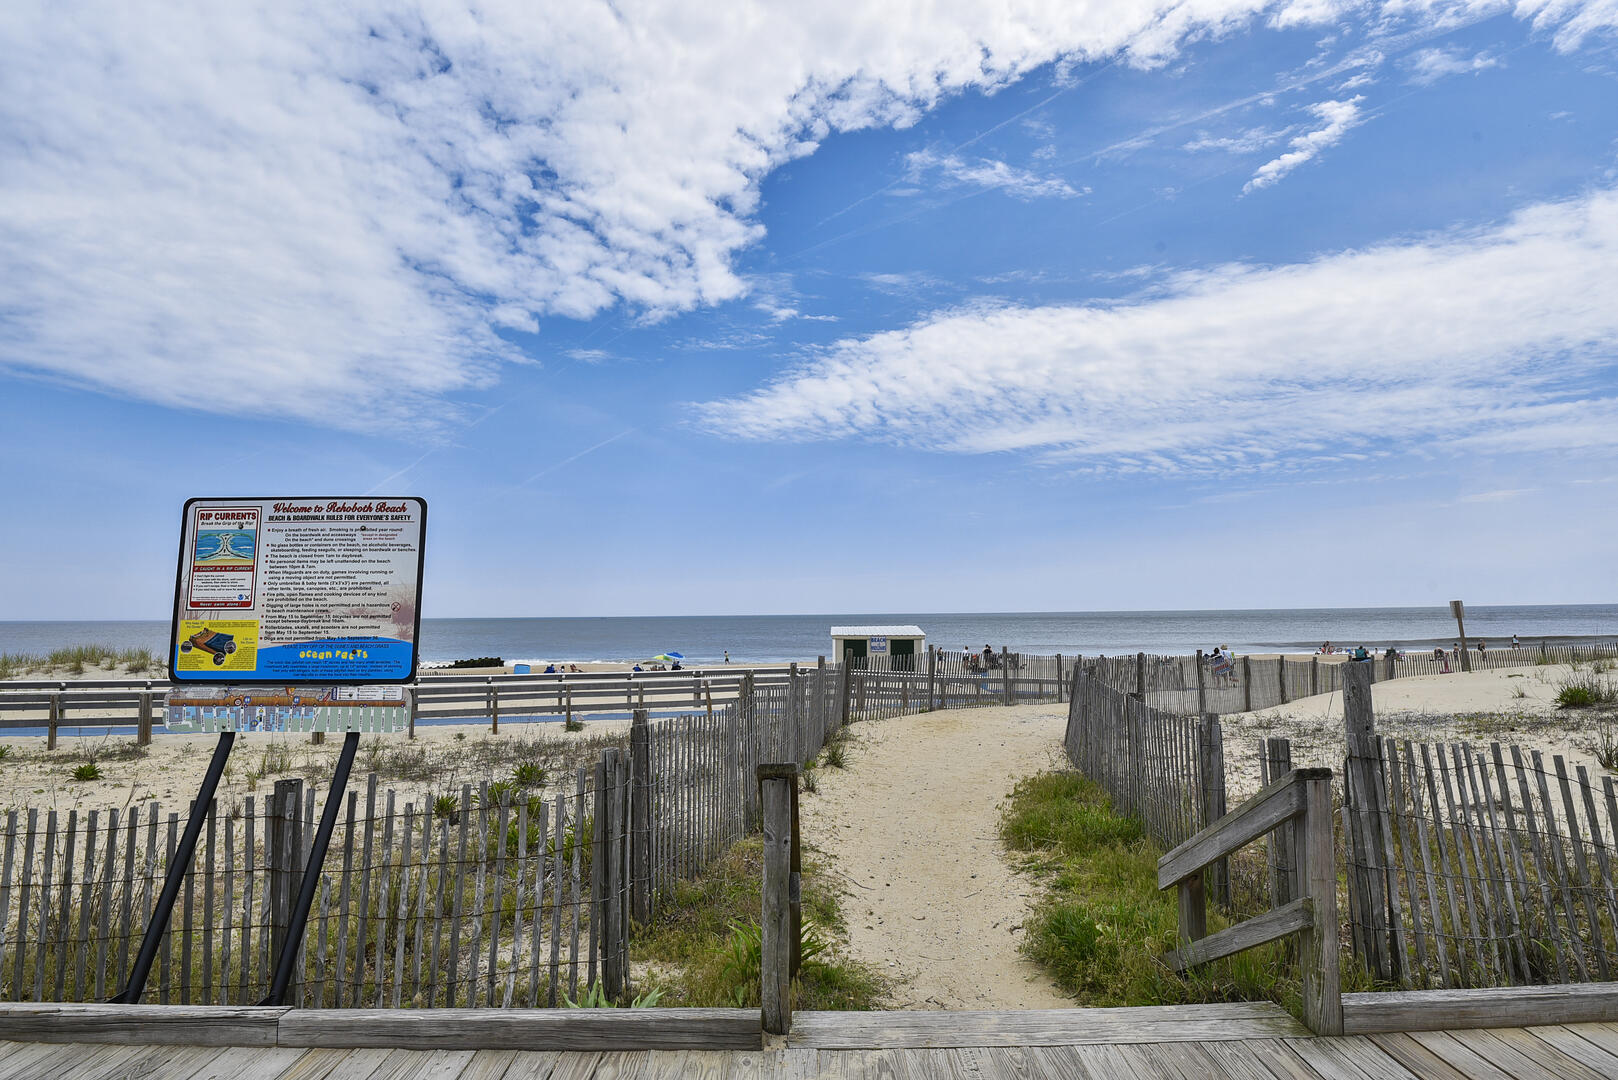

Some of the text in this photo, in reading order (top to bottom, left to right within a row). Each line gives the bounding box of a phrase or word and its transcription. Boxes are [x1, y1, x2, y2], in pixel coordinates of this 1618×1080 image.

[273, 503, 312, 513] Welcome
[326, 502, 373, 512] Rehoboth
[375, 502, 407, 512] Beach
[214, 512, 256, 520] CURRENTS
